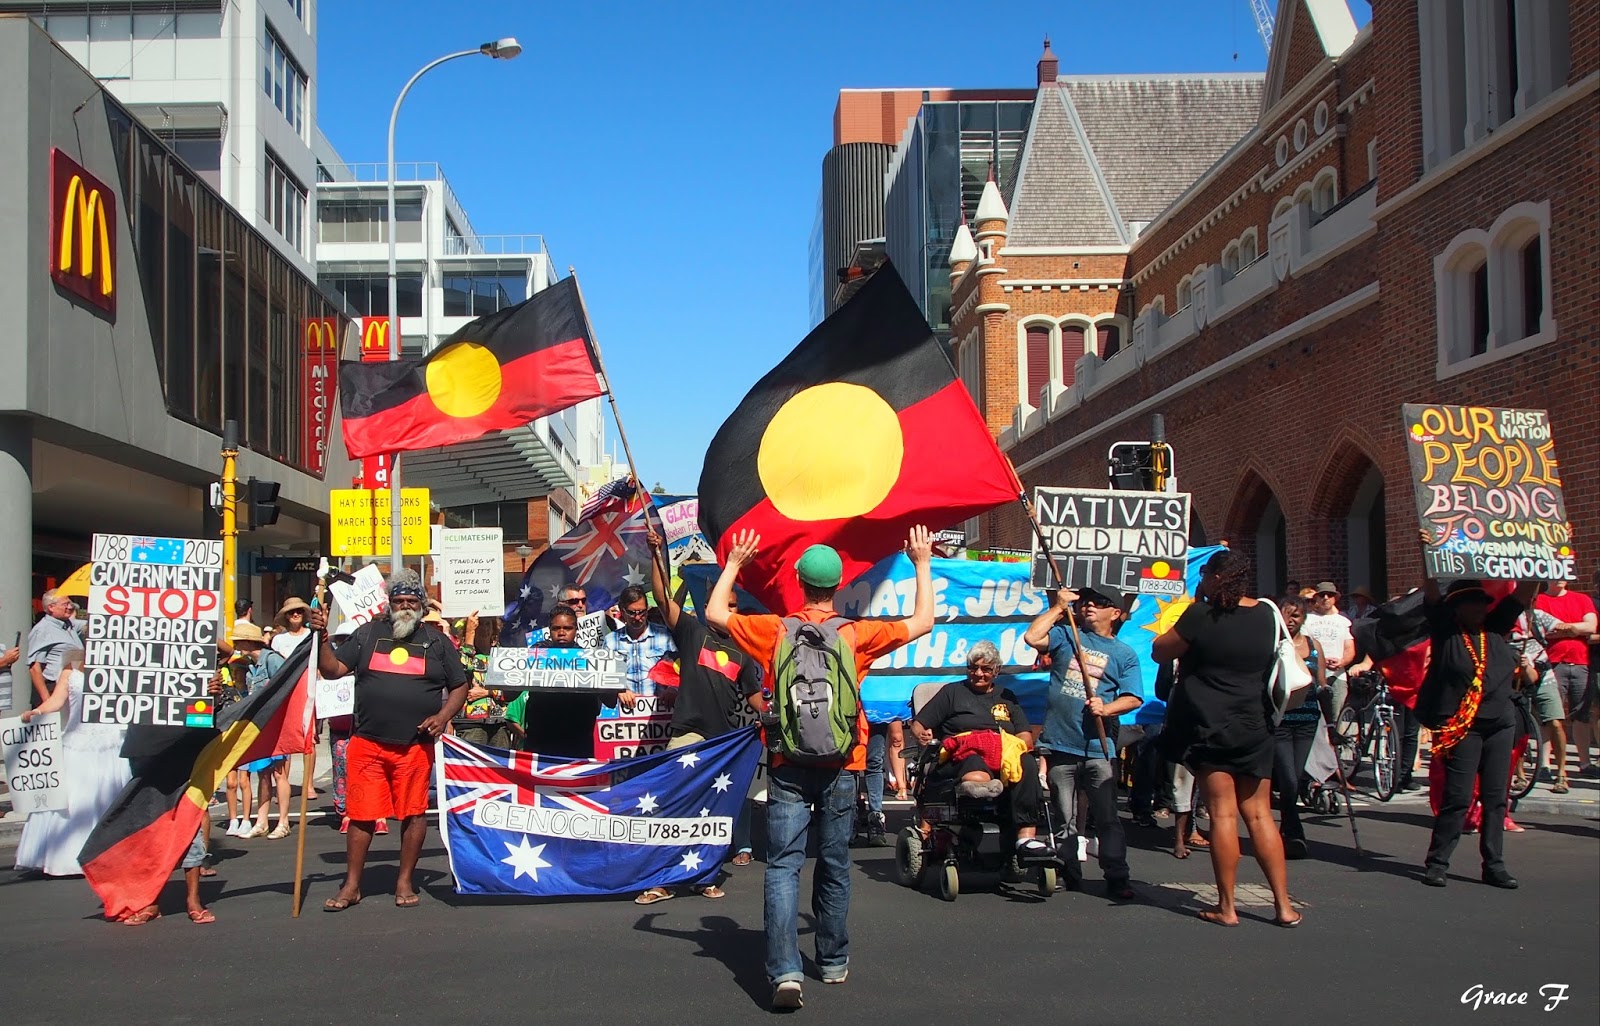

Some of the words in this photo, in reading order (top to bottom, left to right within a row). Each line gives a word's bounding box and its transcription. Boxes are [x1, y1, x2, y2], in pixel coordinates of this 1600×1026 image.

[1422, 406, 1505, 444] OUR
[1421, 439, 1562, 488] PEOPLE
[340, 499, 356, 508] HAY
[360, 498, 389, 508] STREET
[400, 498, 420, 507] ORKS
[1038, 494, 1182, 530] NATIVES
[1424, 484, 1562, 521] BELONG
[338, 517, 365, 526] MARCH
[369, 517, 378, 526] TO
[381, 516, 392, 526] SE
[404, 516, 422, 526] 2015
[1430, 512, 1486, 546] TO
[93, 534, 128, 560] 1788
[184, 540, 222, 565] 2015
[347, 536, 377, 546] EXPECT
[380, 536, 413, 546] DEYS
[1038, 528, 1111, 550] HOLD
[1118, 530, 1188, 558] LAND
[1455, 540, 1558, 560] GOVERNMENT
[90, 562, 220, 590] GOVERNMENT
[294, 562, 315, 570] ANZ
[1037, 554, 1142, 592] TITLE
[1485, 556, 1577, 580] GENOCIDE
[338, 586, 358, 600] WE
[356, 576, 379, 592] WILL
[1141, 580, 1183, 592] 1788-2015
[103, 586, 217, 620] STOP
[354, 590, 378, 612] NOT
[832, 578, 960, 622] MATE,
[964, 580, 1044, 618] JUS
[88, 614, 214, 644] BARBARIC
[85, 640, 208, 670] HANDLING
[490, 646, 528, 658] 1788
[581, 648, 628, 660] 2015
[498, 658, 608, 672] GOVERNMENT
[88, 668, 130, 694] ON
[136, 671, 214, 698] FIRST
[504, 671, 626, 689] SHAME
[82, 694, 185, 726] PEOPLE
[2, 722, 58, 746] CLIMATE
[600, 722, 636, 740] GET
[638, 722, 664, 739] RID
[18, 748, 52, 768] SOS
[11, 771, 60, 792] CRISIS
[480, 802, 647, 843] GENOCIDE
[649, 822, 728, 840] 1788-2015
